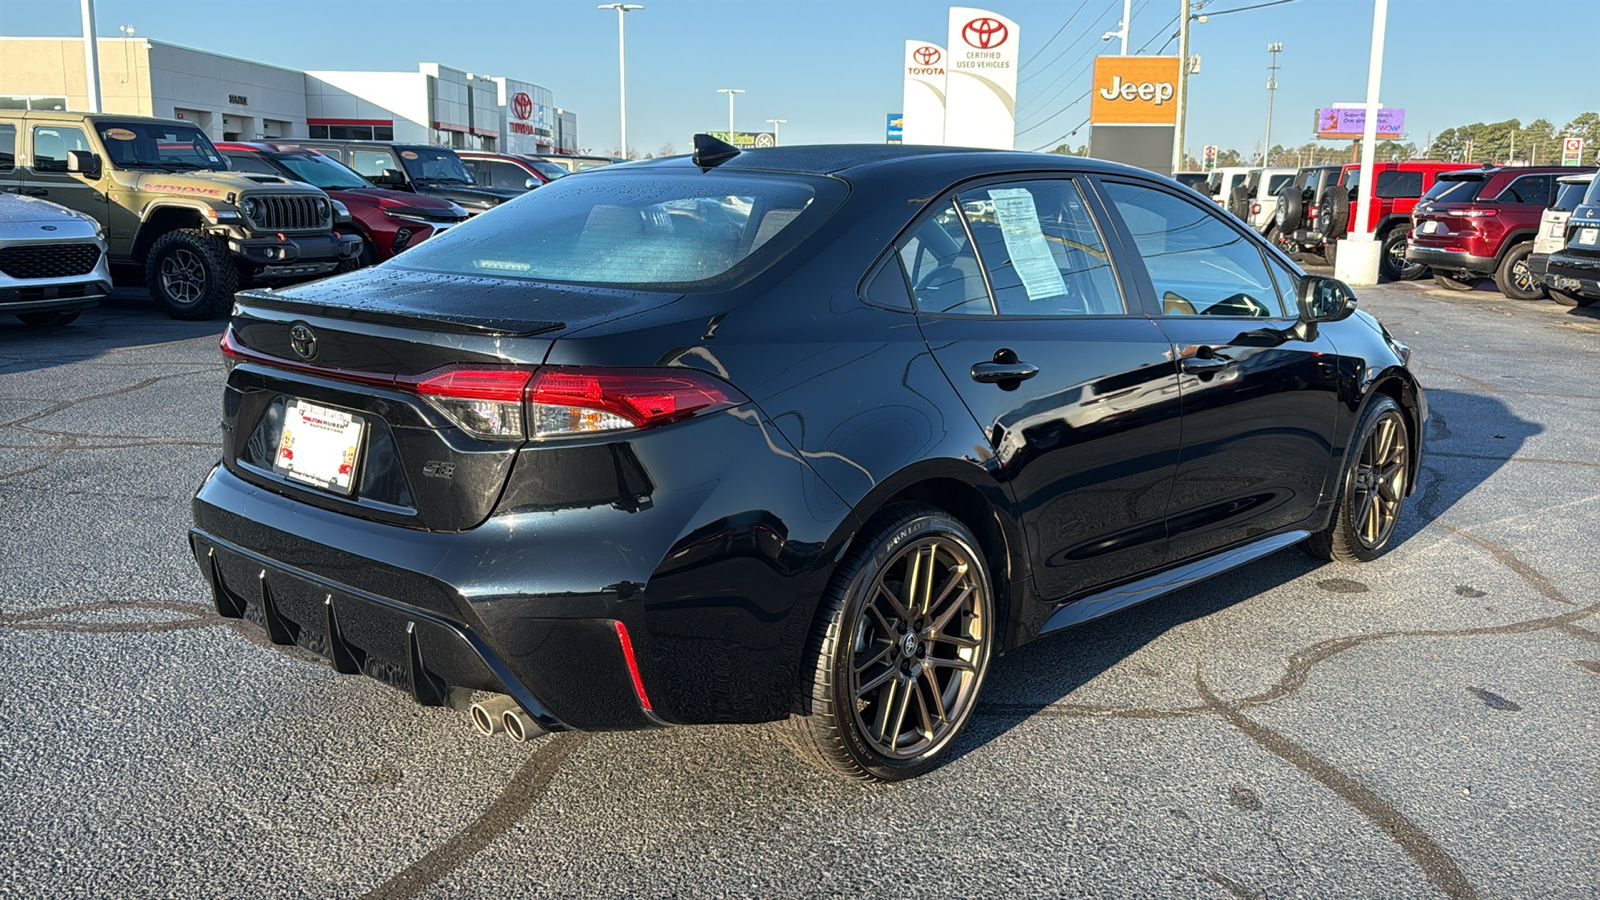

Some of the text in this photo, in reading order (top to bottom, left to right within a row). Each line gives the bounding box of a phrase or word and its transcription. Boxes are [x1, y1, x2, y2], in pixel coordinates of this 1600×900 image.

[966, 51, 1001, 60] CERTIFIED
[956, 60, 1010, 69] USED VEHICLES
[907, 67, 945, 76] TOYOTA
[1100, 75, 1174, 106] Jeep
[511, 122, 534, 135] TOYOTA
[143, 183, 221, 196] MOJAVE
[322, 420, 345, 430] RUBEN
[422, 461, 456, 479] SE
